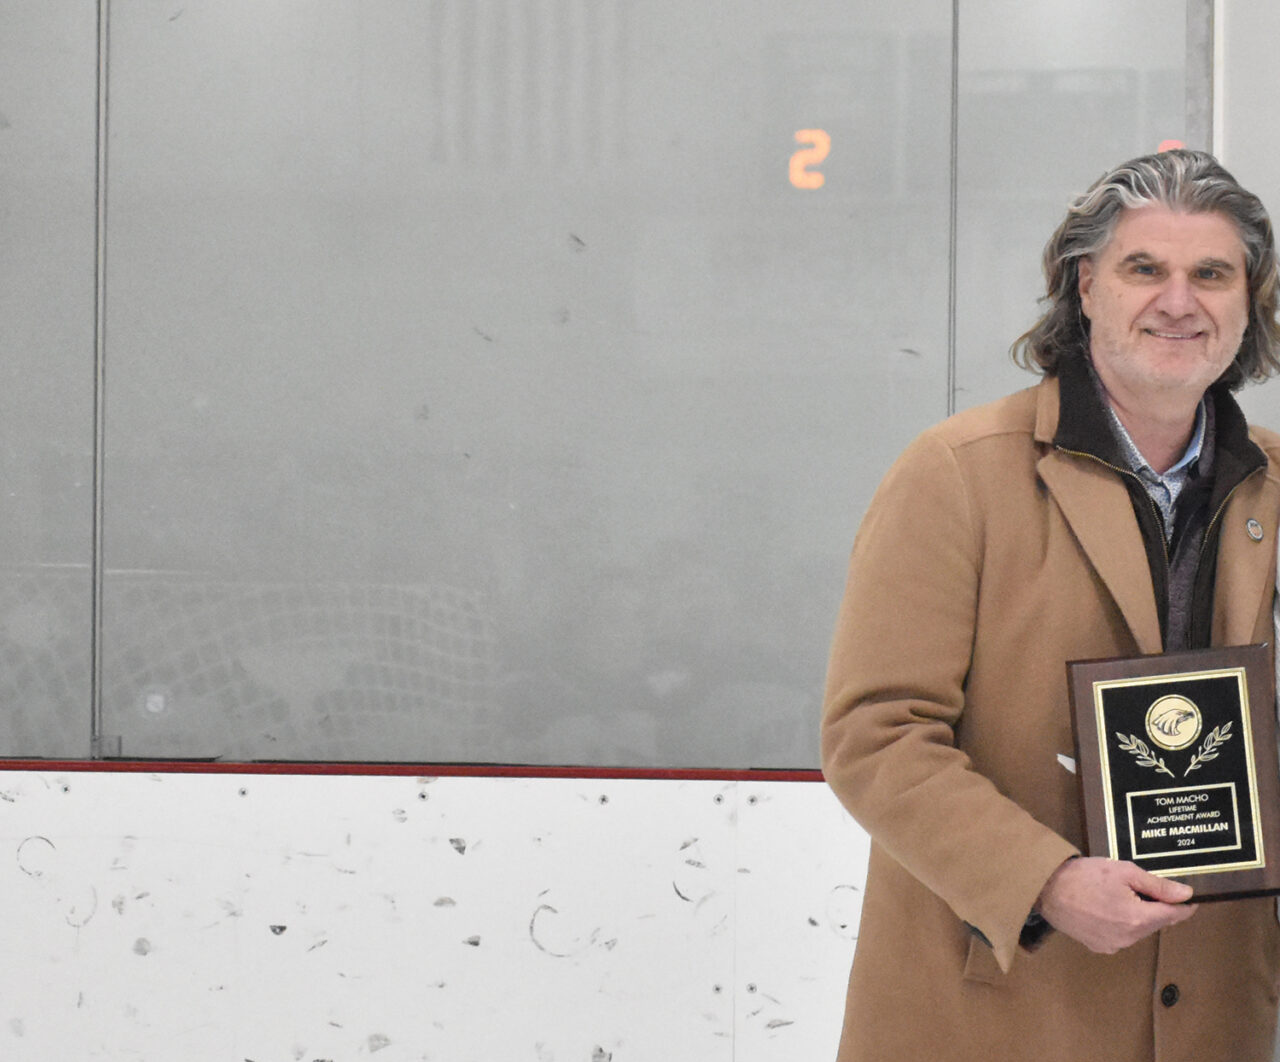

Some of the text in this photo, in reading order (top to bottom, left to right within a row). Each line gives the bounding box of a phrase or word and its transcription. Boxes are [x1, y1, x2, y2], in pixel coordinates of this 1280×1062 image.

[1155, 793, 1209, 806] TOM MACHO
[1168, 804, 1197, 814] LIFETIME
[1146, 810, 1221, 824] ACHIEVEMENT AWARD
[1141, 822, 1229, 839] MIKE MACMILLAN
[1177, 838, 1195, 847] 2024
